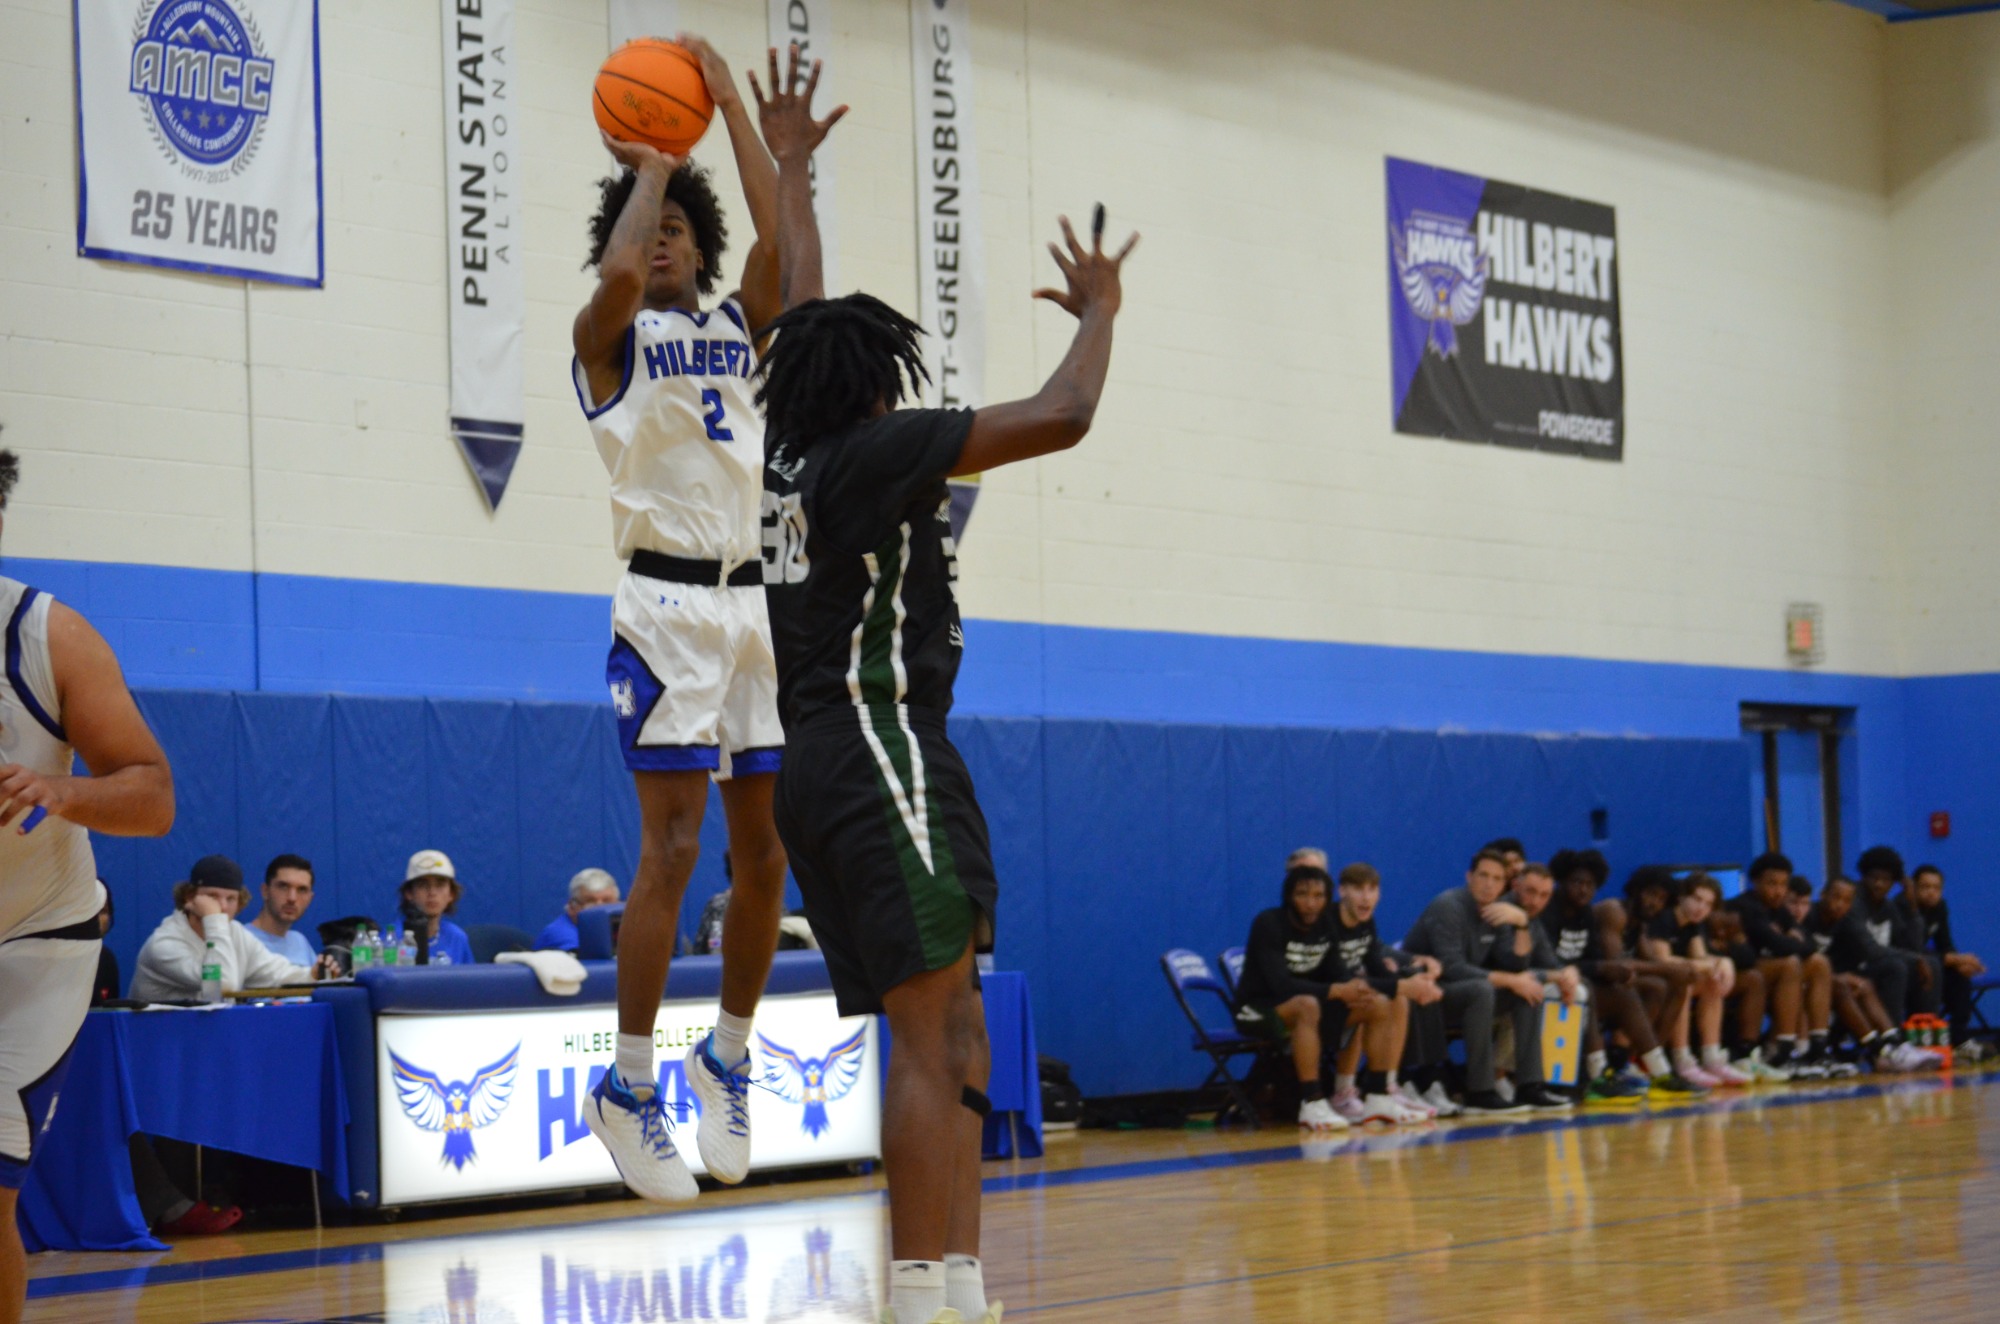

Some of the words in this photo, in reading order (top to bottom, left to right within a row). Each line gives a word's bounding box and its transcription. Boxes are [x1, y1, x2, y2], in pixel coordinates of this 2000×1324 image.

[204, 3, 240, 45] MOUNTAIN
[131, 40, 273, 112] AMCC
[456, 0, 486, 148] STATE
[161, 101, 203, 150] COLLEGIATE
[491, 46, 509, 264] ALTOONA
[131, 189, 176, 240] 25
[186, 197, 278, 255] YEARS
[460, 162, 488, 308] PENN
[933, 24, 960, 409] TT-GREENSBURG
[1477, 209, 1615, 301] HILBERT
[643, 339, 751, 381] HILBERT
[1483, 297, 1614, 384] HAWKS
[701, 387, 735, 442] 2
[655, 1026, 716, 1049] OLLEG
